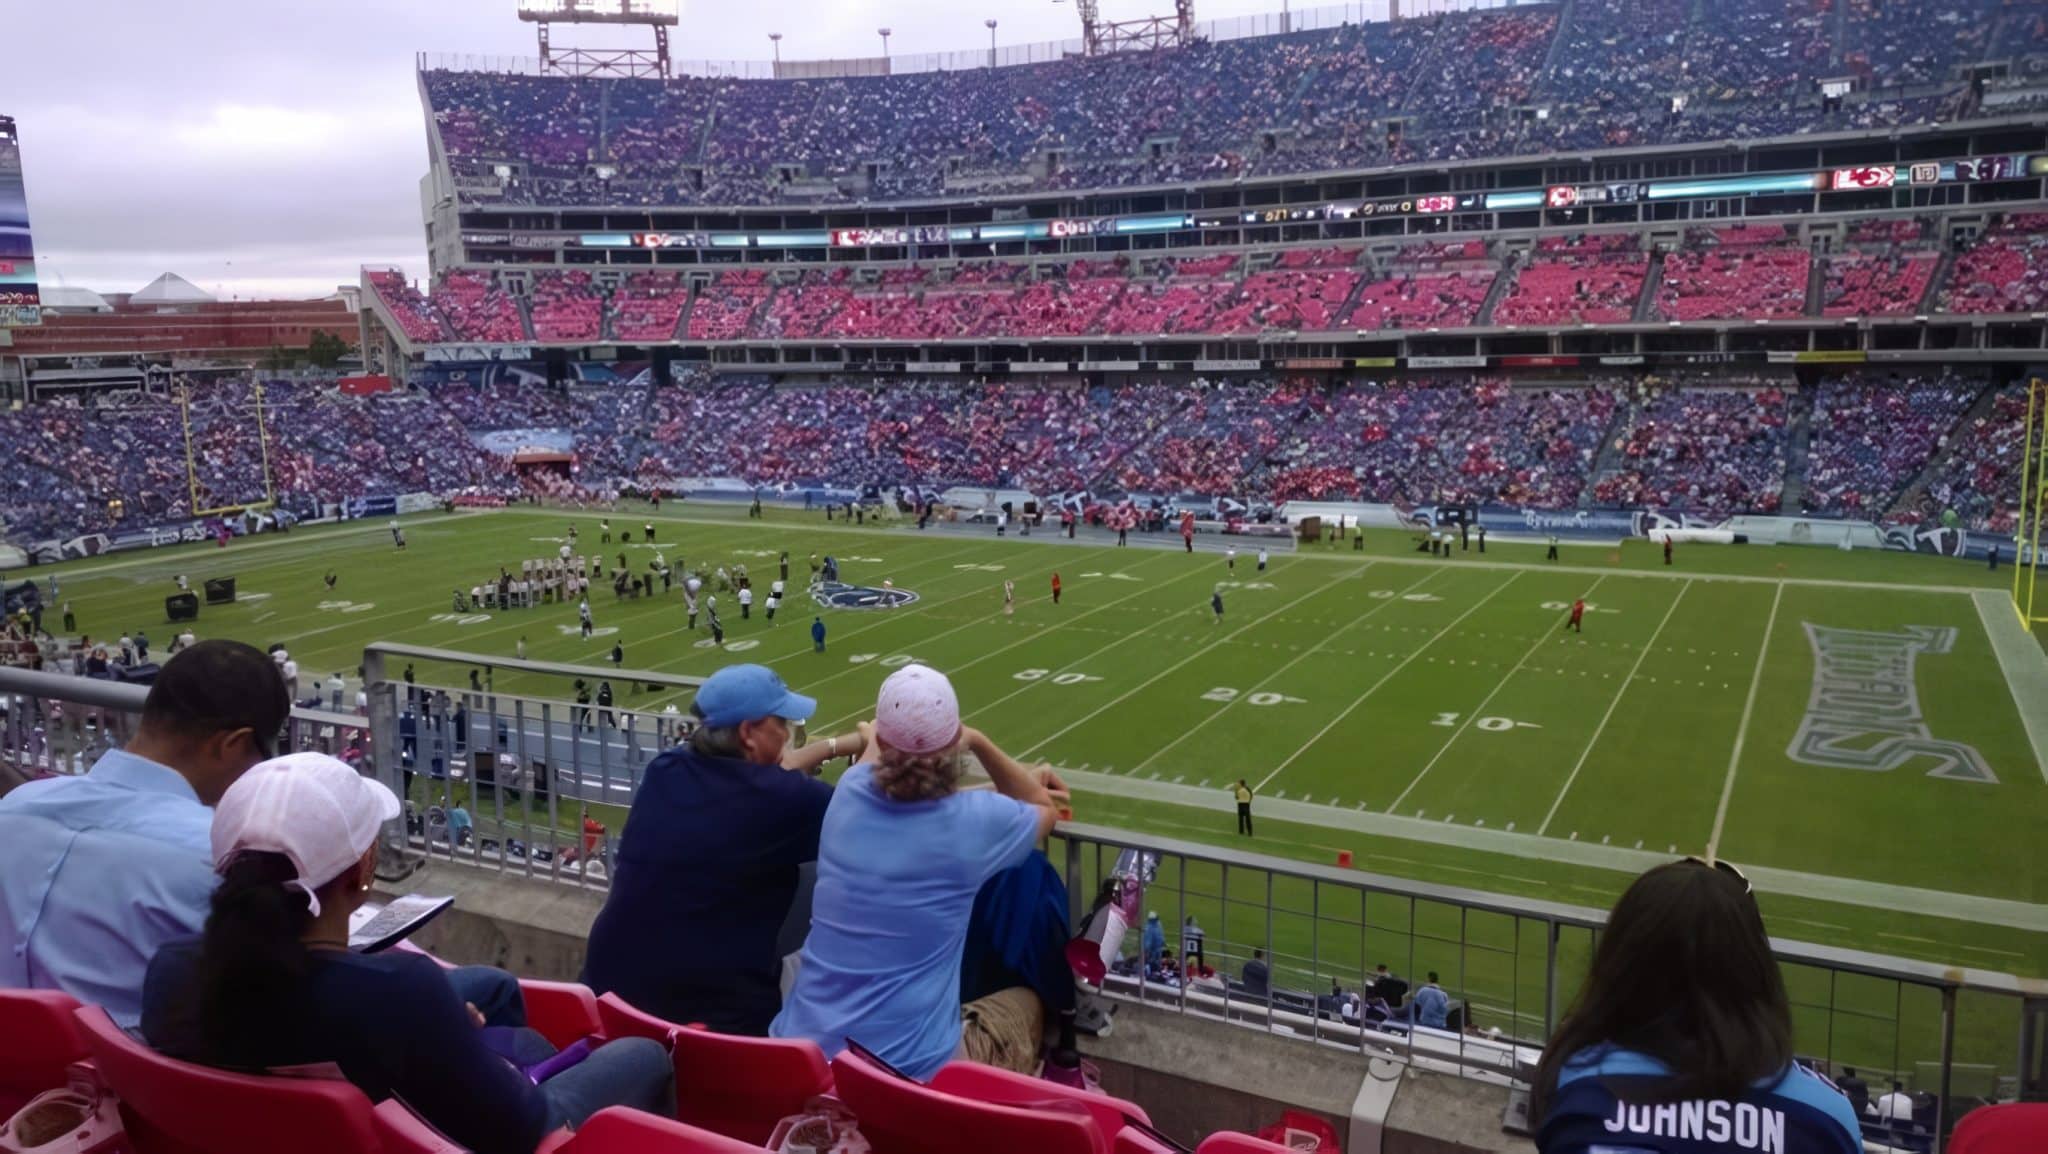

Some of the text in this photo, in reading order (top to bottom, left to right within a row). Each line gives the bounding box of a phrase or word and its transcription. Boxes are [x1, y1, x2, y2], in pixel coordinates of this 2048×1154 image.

[1199, 686, 1284, 706] 20
[1430, 712, 1516, 732] 10
[1603, 1098, 1785, 1154] JOHNSON
